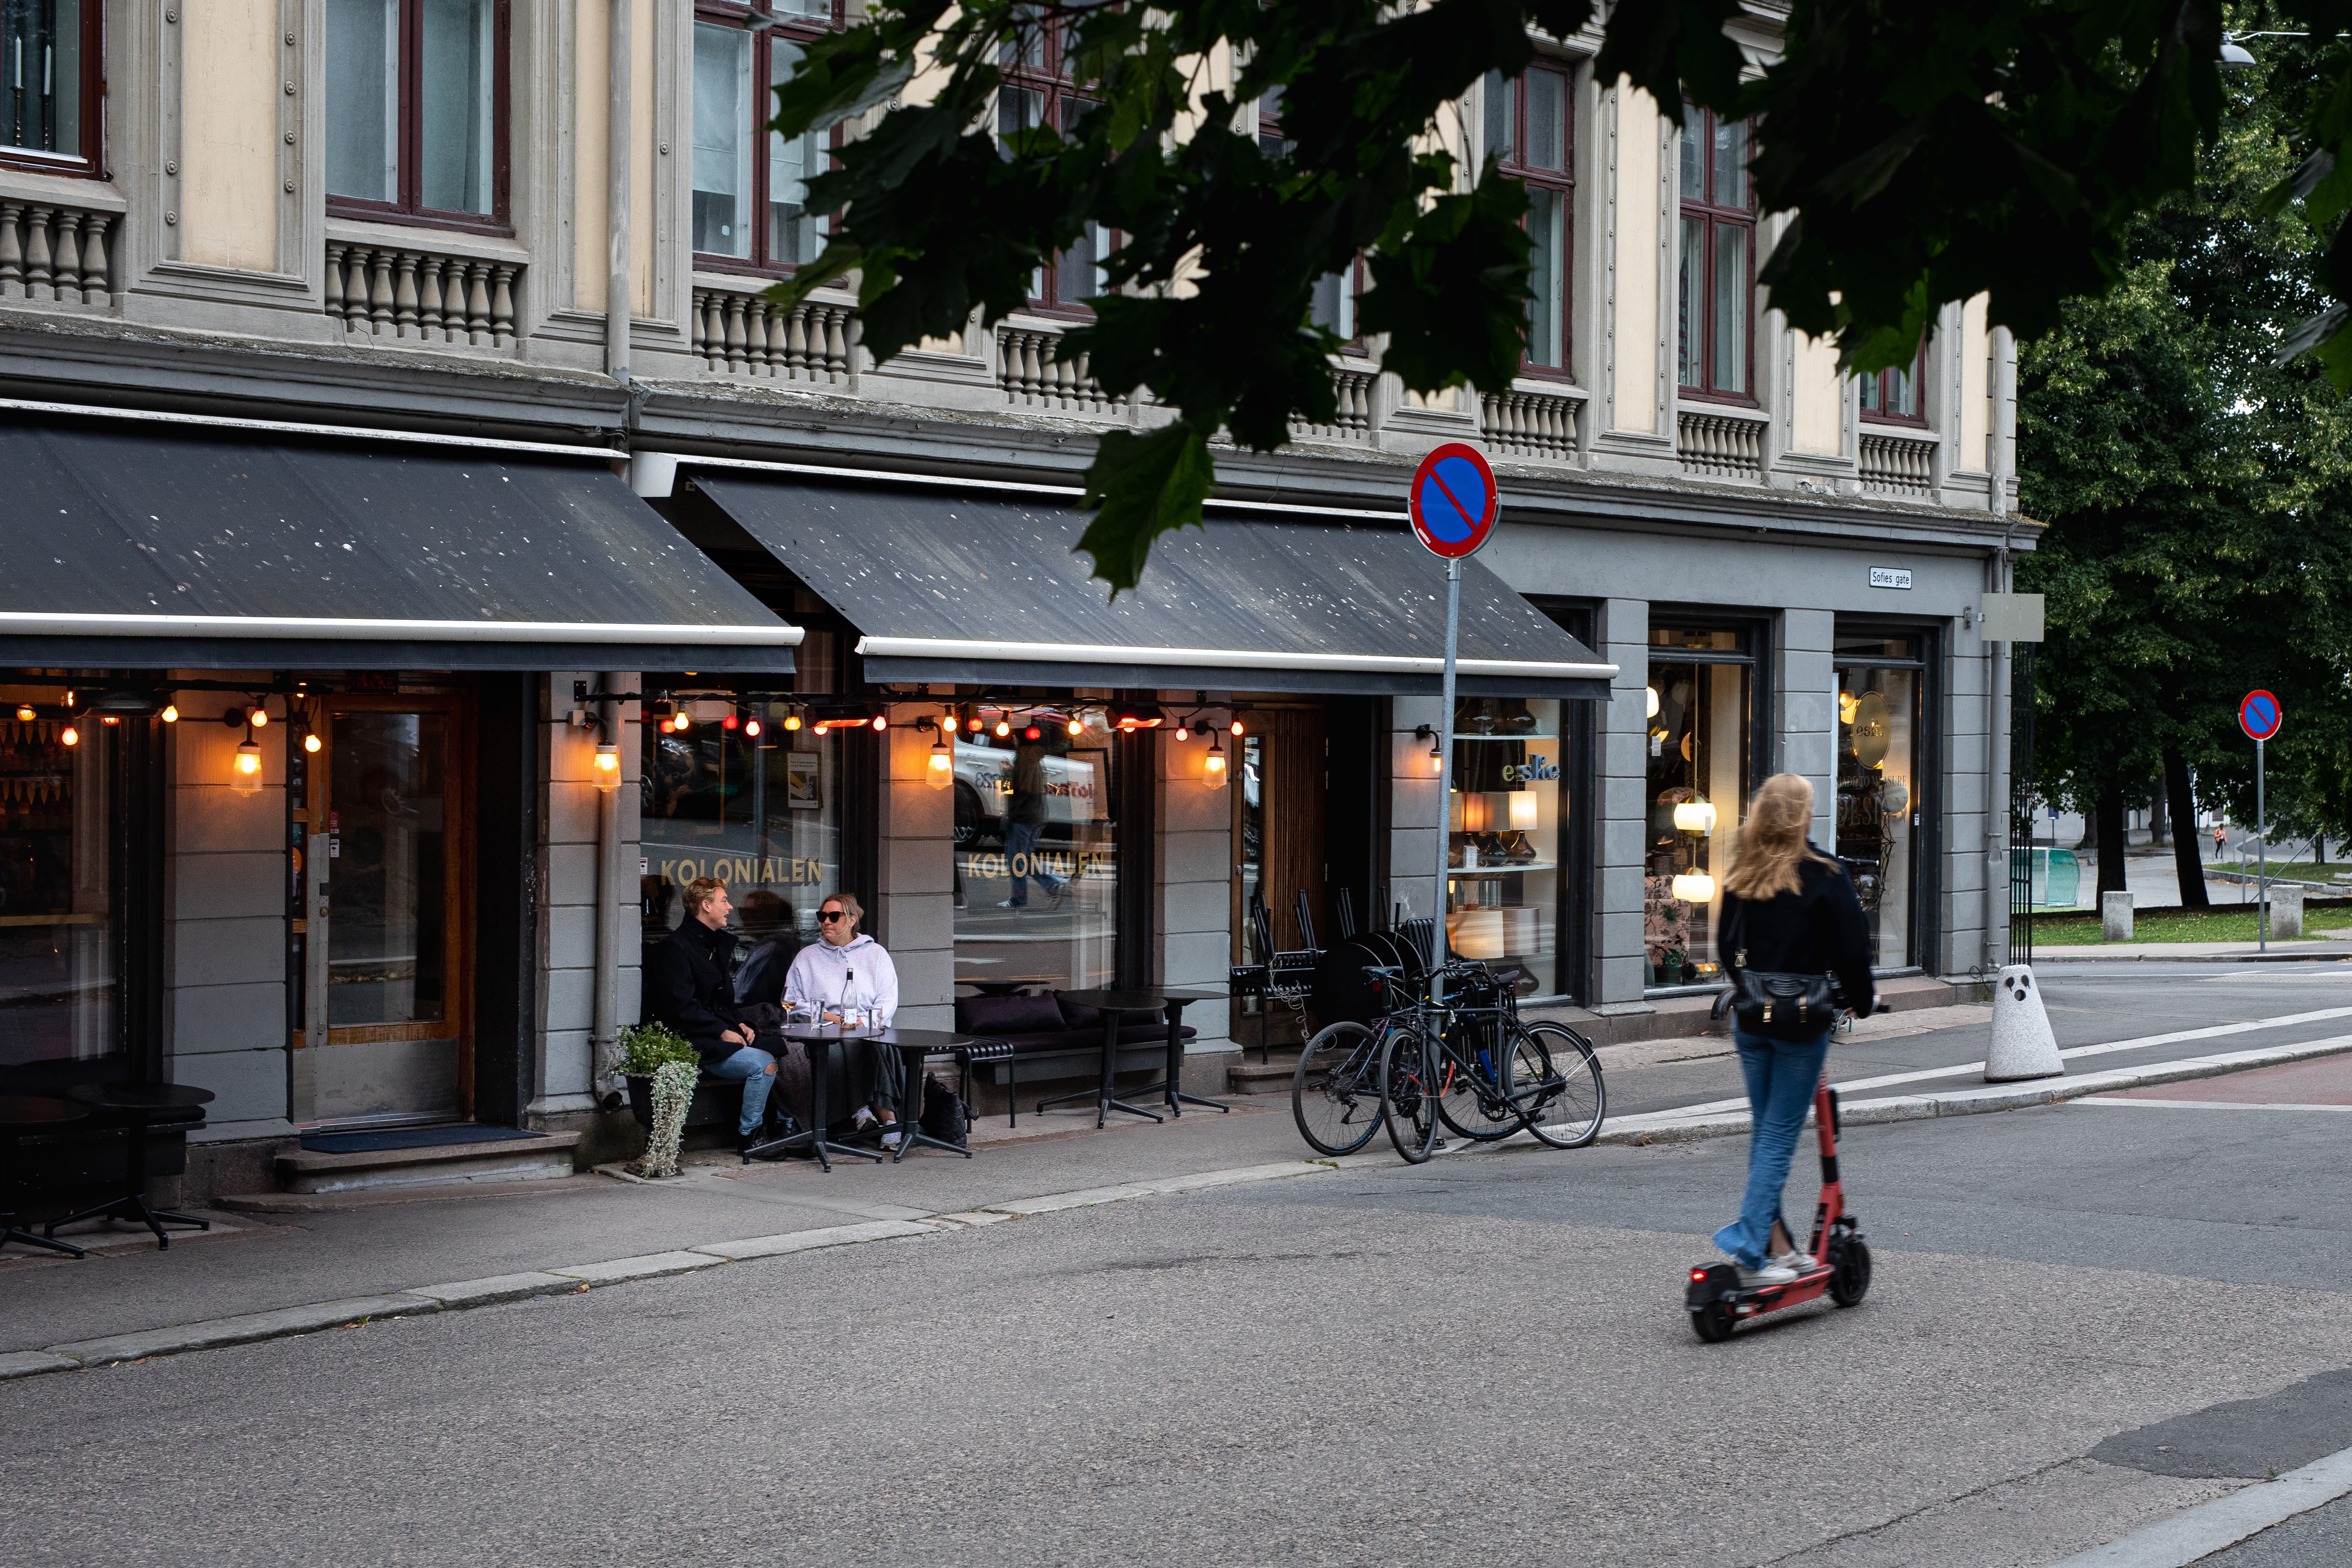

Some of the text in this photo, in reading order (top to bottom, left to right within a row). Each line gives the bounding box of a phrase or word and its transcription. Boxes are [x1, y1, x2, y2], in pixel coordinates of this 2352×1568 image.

[1873, 572, 1909, 586] Sofies gate
[1836, 775, 1857, 788] MADE
[1859, 775, 1870, 788] TO
[968, 851, 1105, 878] KOLONIALEN
